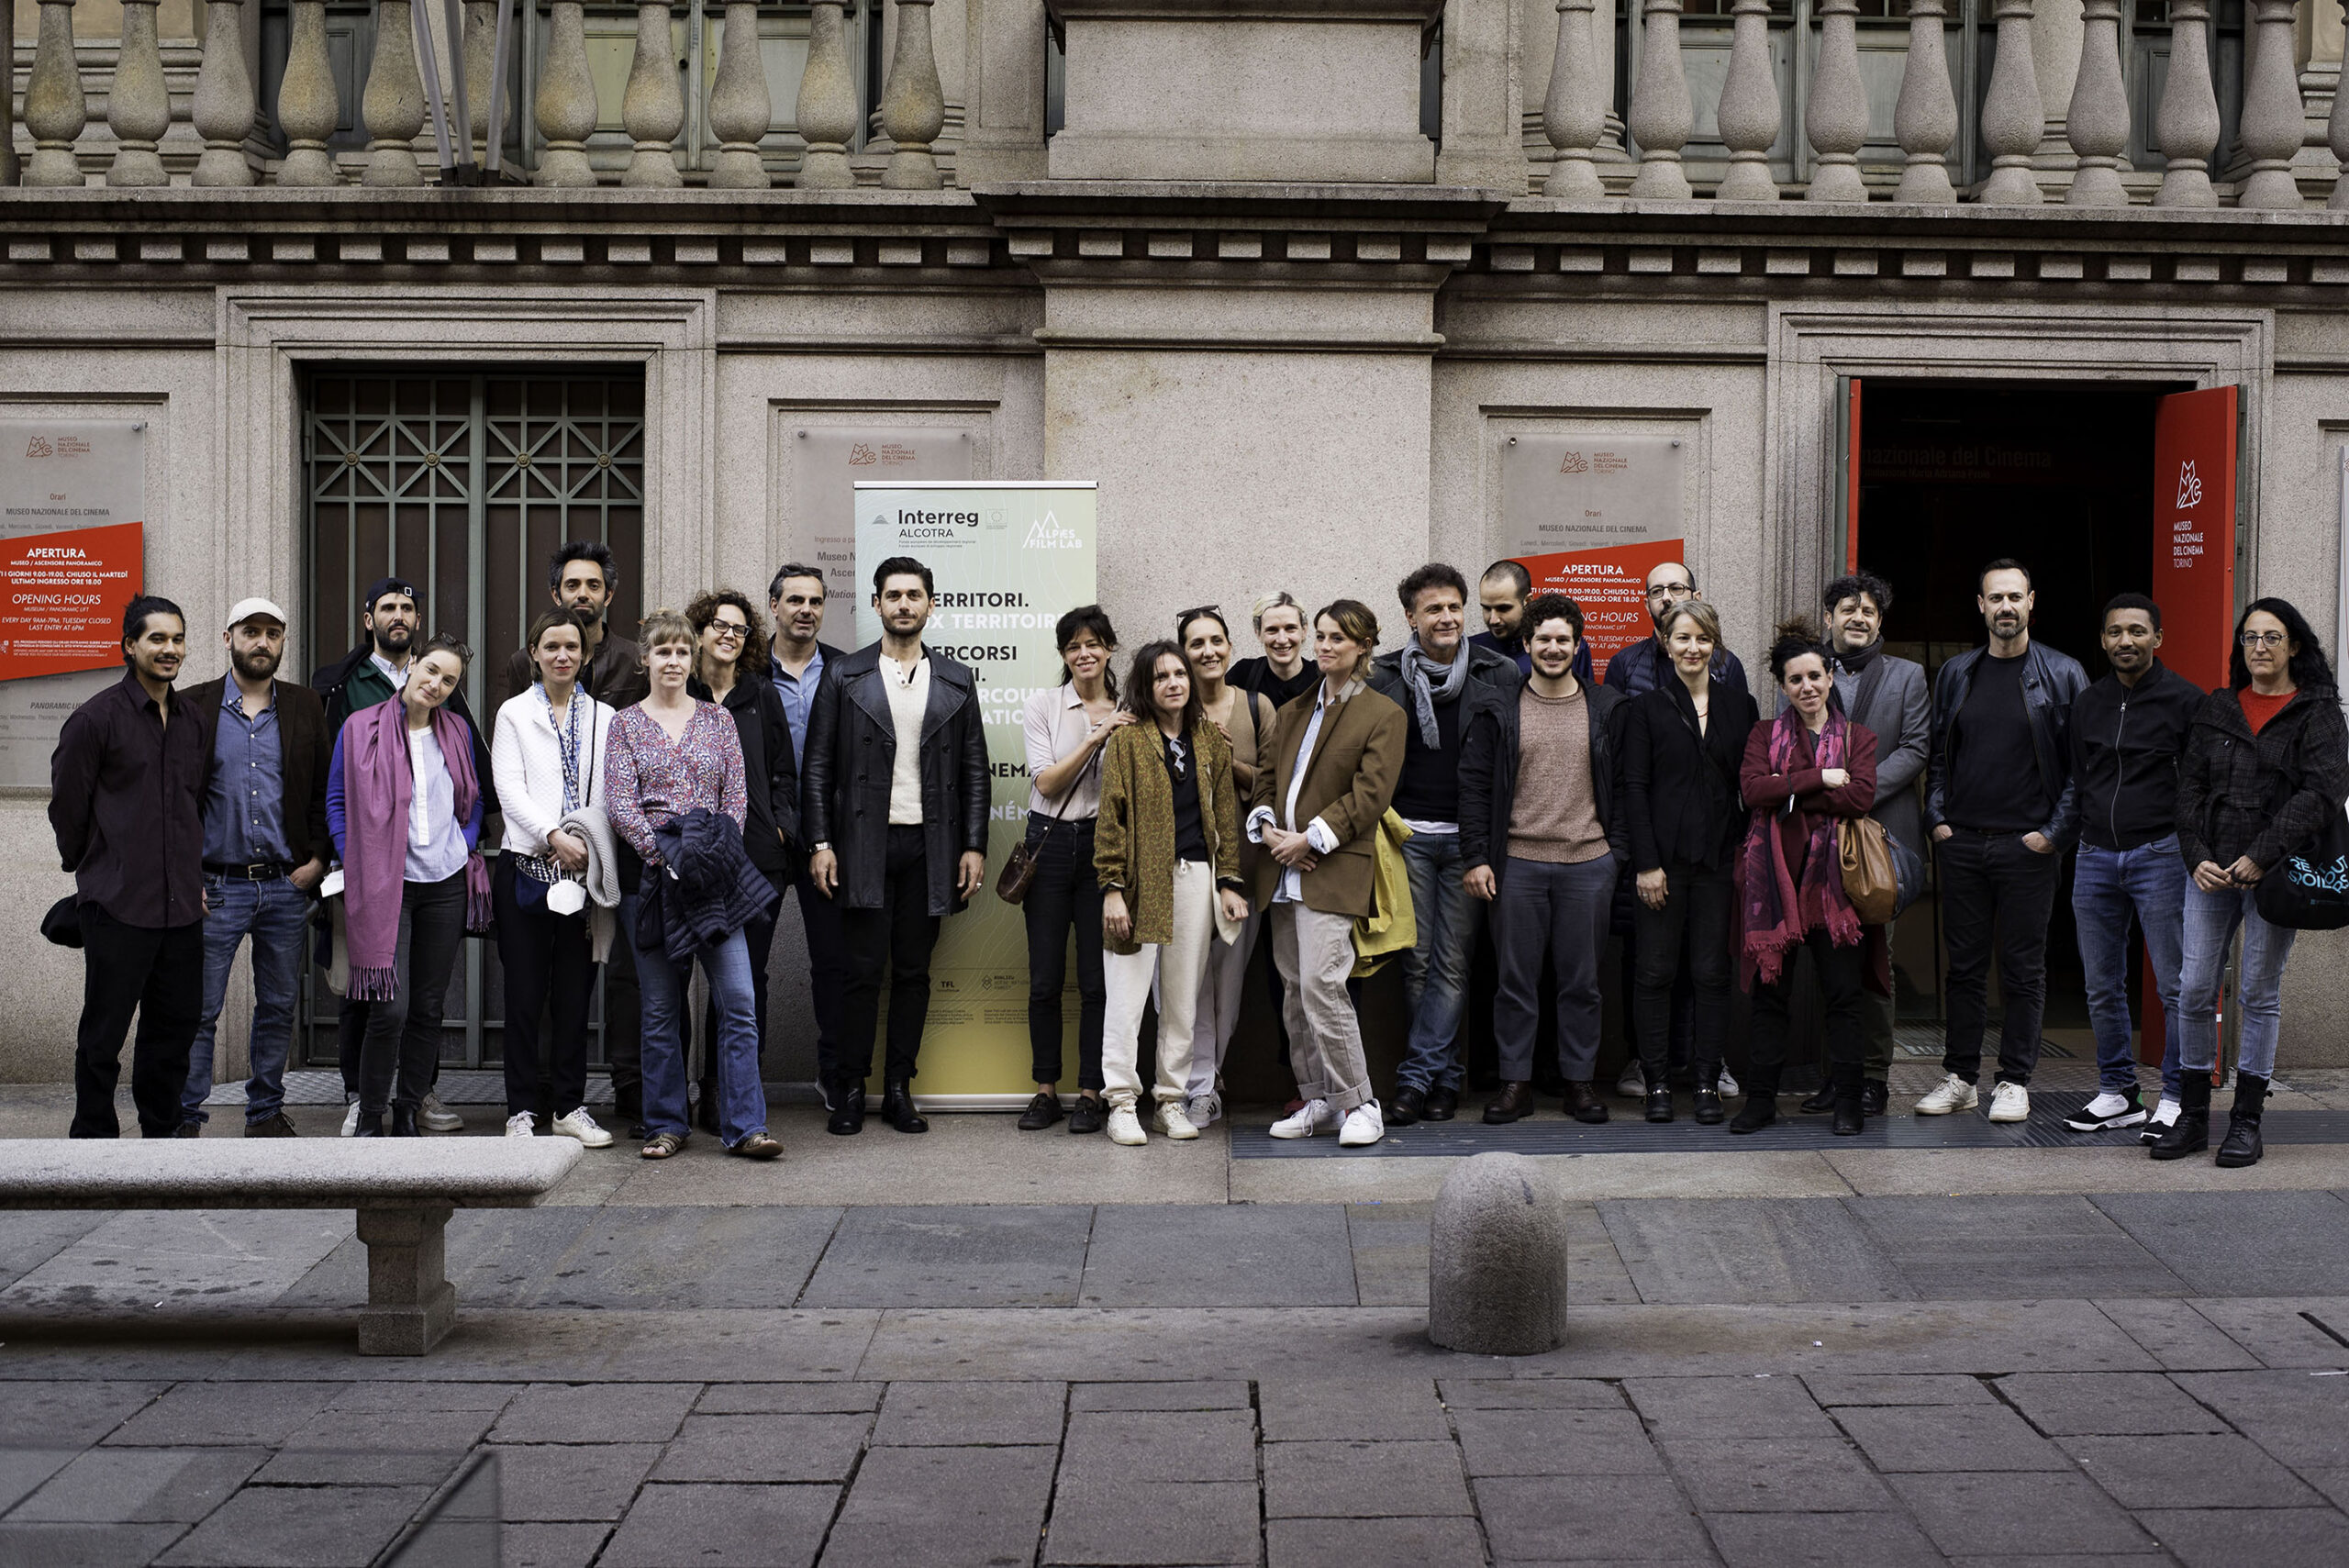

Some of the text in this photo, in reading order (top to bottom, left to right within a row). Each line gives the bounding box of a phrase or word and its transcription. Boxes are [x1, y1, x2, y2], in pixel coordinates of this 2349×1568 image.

[50, 493, 66, 501] Orari
[898, 509, 979, 528] Interreg
[1585, 509, 1602, 517] Orari
[1539, 524, 1564, 532] MUSEO
[1620, 525, 1648, 533] CINEMA
[2174, 521, 2192, 531] MUSEO
[899, 528, 954, 538] ALCOTRA
[2174, 532, 2204, 543] NAZIONALE
[814, 536, 841, 545] Ingresso
[1030, 539, 1083, 549] FILM LAB
[27, 548, 86, 559] APERTURA
[2173, 545, 2204, 556] DEL CINEMA
[817, 551, 848, 562] Museo
[2173, 558, 2193, 569] TORINO
[1562, 564, 1624, 575] APERTURA
[11, 594, 102, 605] OPENING HOURS
[934, 592, 1030, 607] ERRITORI.
[952, 614, 1063, 629] TERRITOIR
[1600, 612, 1639, 623] HOURS
[932, 646, 1018, 661] ERCORSI
[30, 702, 72, 710] PANORAMIC
